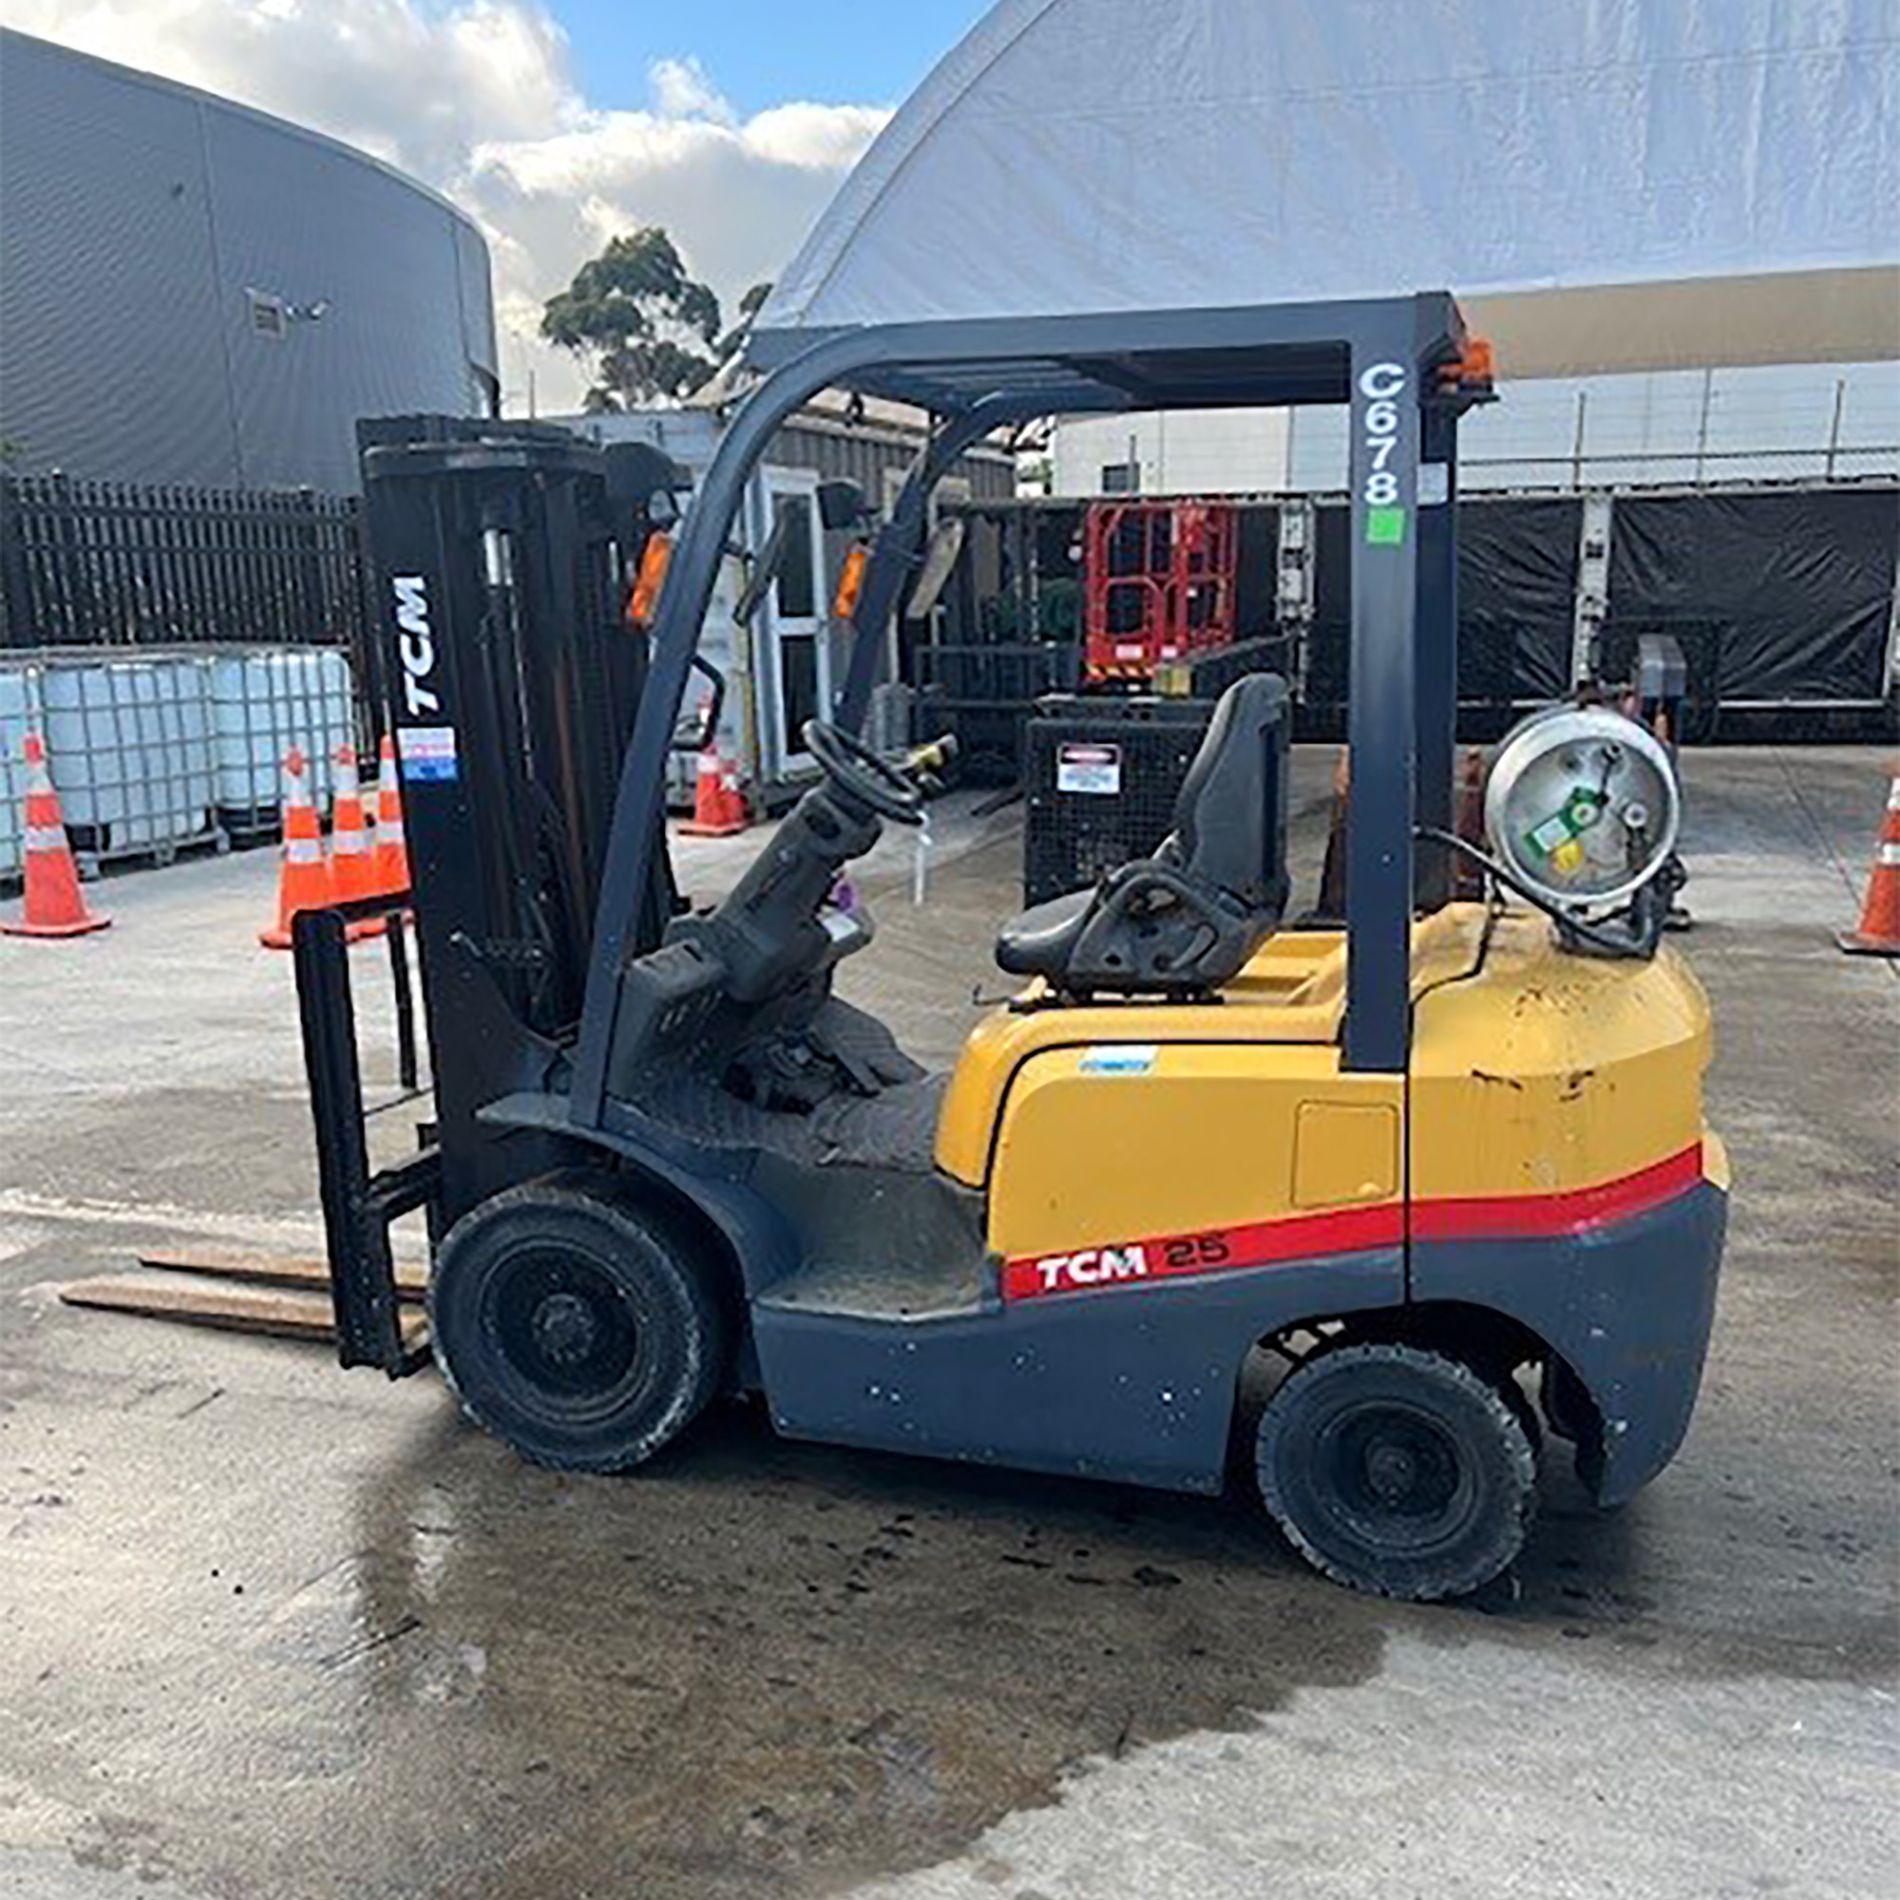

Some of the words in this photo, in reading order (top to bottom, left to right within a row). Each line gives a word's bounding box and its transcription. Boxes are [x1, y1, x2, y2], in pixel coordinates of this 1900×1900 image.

[1359, 362, 1406, 505] C678
[393, 576, 440, 717] TCM
[1037, 1246, 1147, 1289] TCM
[1164, 1232, 1229, 1267] 25
